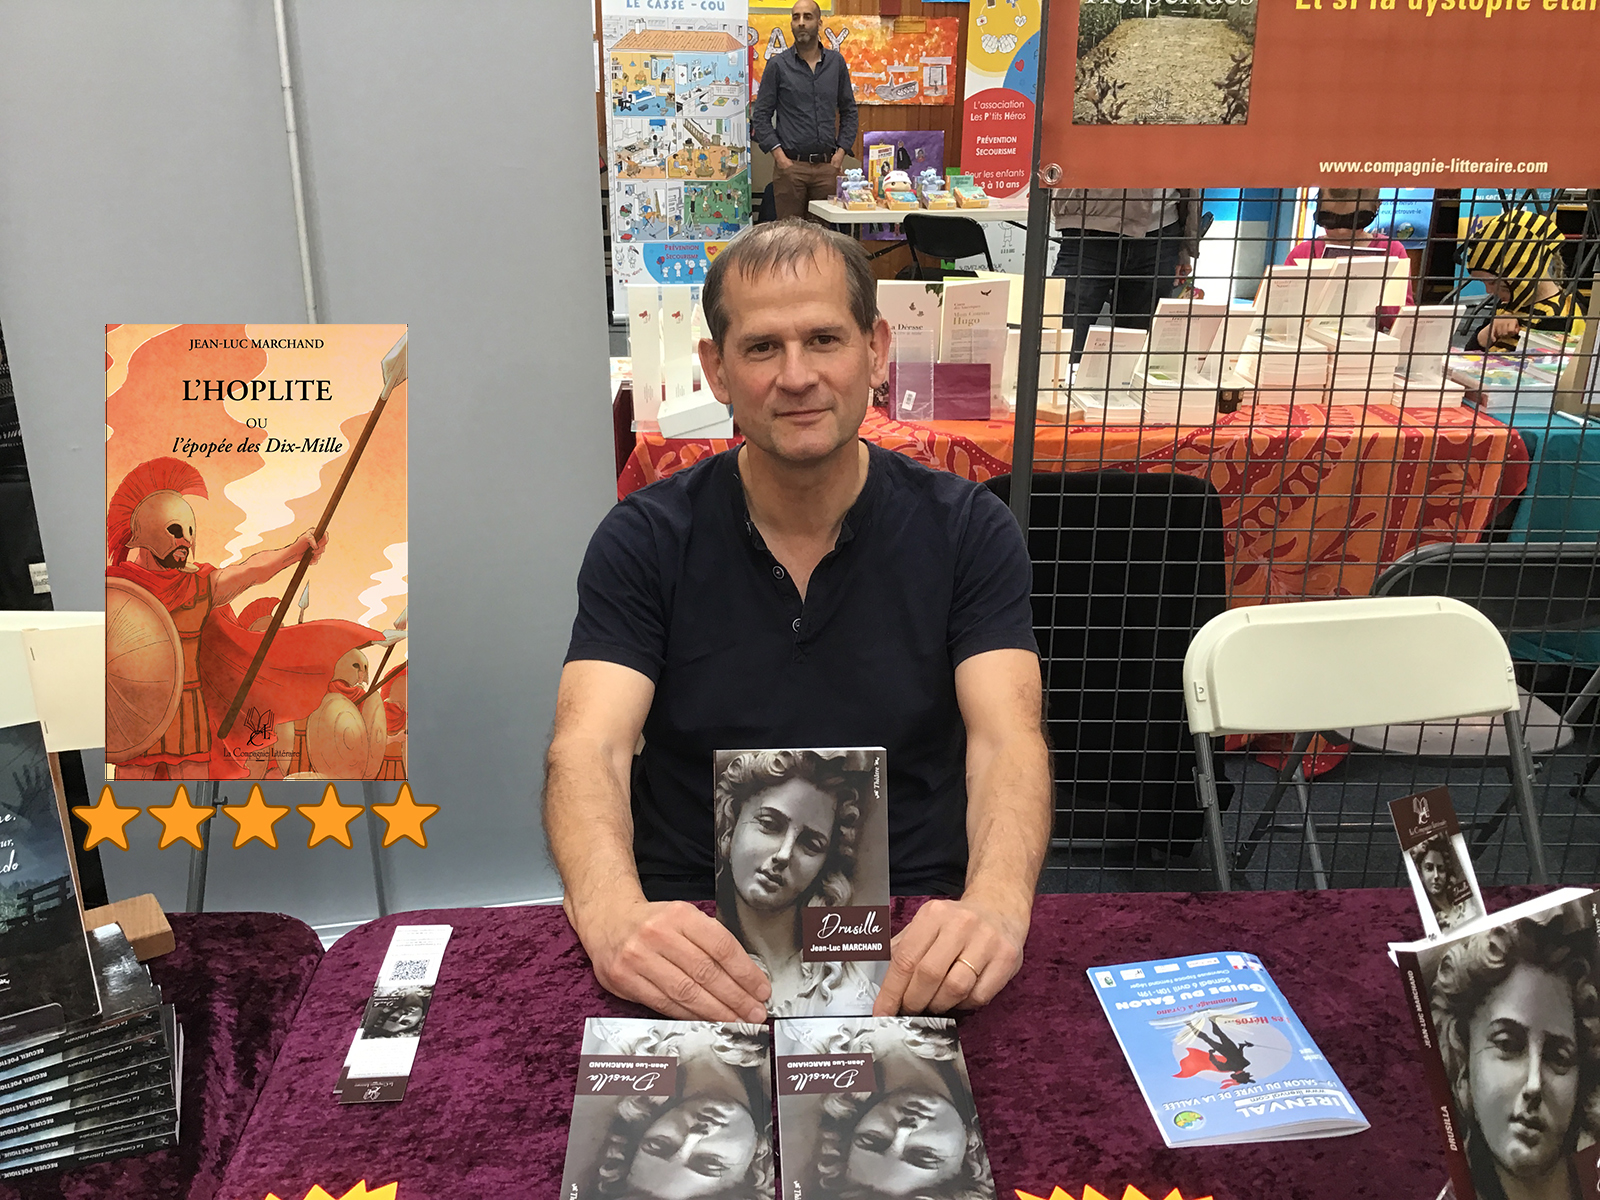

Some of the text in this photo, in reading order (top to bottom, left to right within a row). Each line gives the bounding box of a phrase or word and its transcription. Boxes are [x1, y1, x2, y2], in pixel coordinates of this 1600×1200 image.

[647, 0, 684, 10] CASSE
[700, 1, 724, 11] COU
[974, 101, 1024, 109] L'association
[971, 113, 982, 121] Les
[1004, 111, 1026, 120] Héros
[977, 136, 1017, 144] PRÉVENTION
[976, 148, 1016, 156] SECOURISME
[1319, 158, 1548, 176] www.compagnie-litteraire.com
[996, 169, 1025, 178] enfants
[996, 181, 1004, 189] 10
[954, 318, 980, 326] Hugo
[817, 911, 883, 939] Drusilla
[1199, 977, 1231, 987] Samedi
[1174, 984, 1190, 993] avril
[1115, 983, 1266, 1010] GUIDE DU SALON
[1196, 997, 1238, 1008] Hommage
[1157, 1006, 1186, 1016] Cyrano
[1407, 970, 1432, 1048] JEAN-LUC MARCHAND
[20, 1048, 44, 1059] RECUEIL
[23, 1072, 47, 1082] RECUEIL
[586, 1072, 660, 1091] Drusilla
[787, 1069, 859, 1091] Drusilla
[1285, 1079, 1315, 1088] SALON
[1234, 1084, 1261, 1096] LIVRE
[29, 1096, 52, 1106] RECUEIL
[1163, 1097, 1198, 1110] VALLÉE
[1236, 1091, 1355, 1117] LIRENVAL
[30, 1118, 54, 1128] RECUEIL
[1441, 1106, 1458, 1152] DRUSILLA
[34, 1141, 58, 1151] RECUEIL
[34, 1162, 58, 1172] RECUEIL
